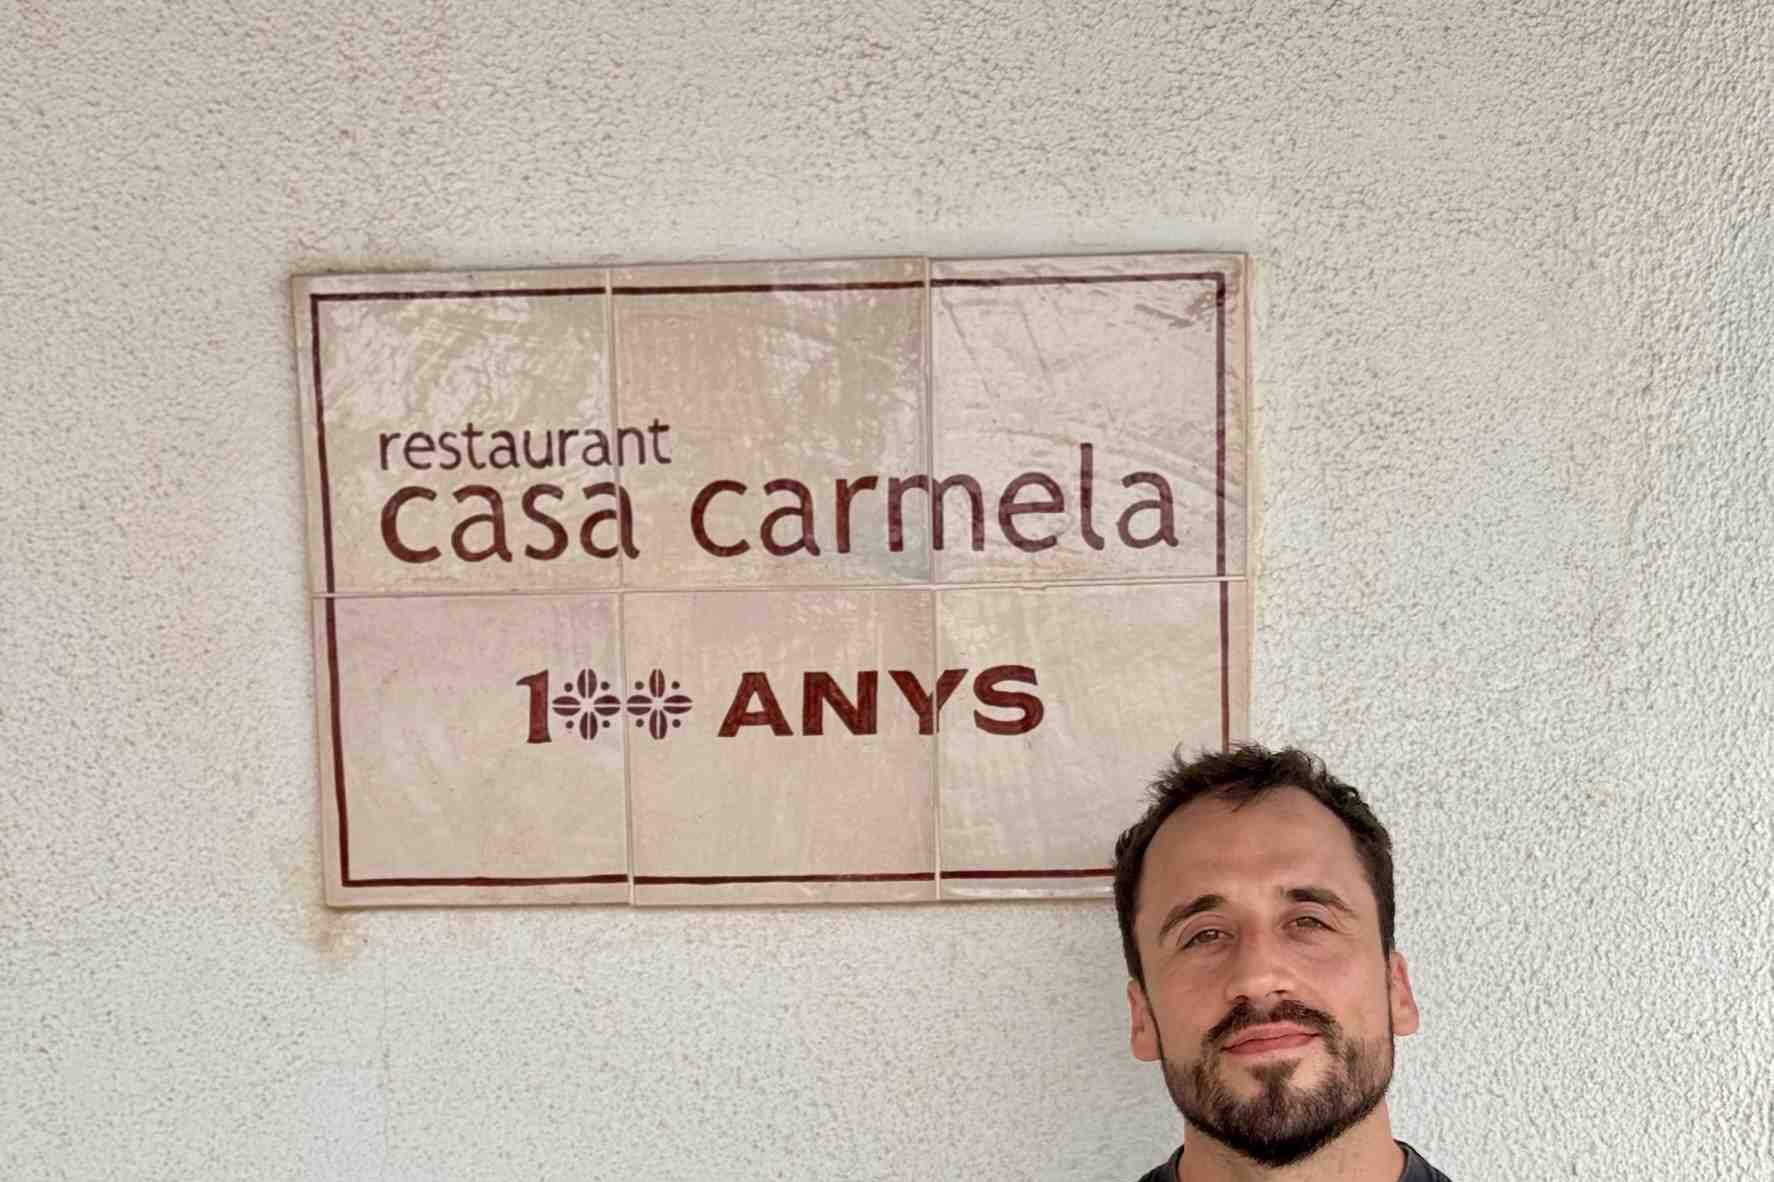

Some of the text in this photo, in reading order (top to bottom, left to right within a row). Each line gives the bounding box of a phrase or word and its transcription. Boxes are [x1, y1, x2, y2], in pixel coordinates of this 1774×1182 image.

[379, 418, 672, 472] restaurant
[380, 442, 1180, 564] casa carmela
[717, 664, 1046, 738] ANYS
